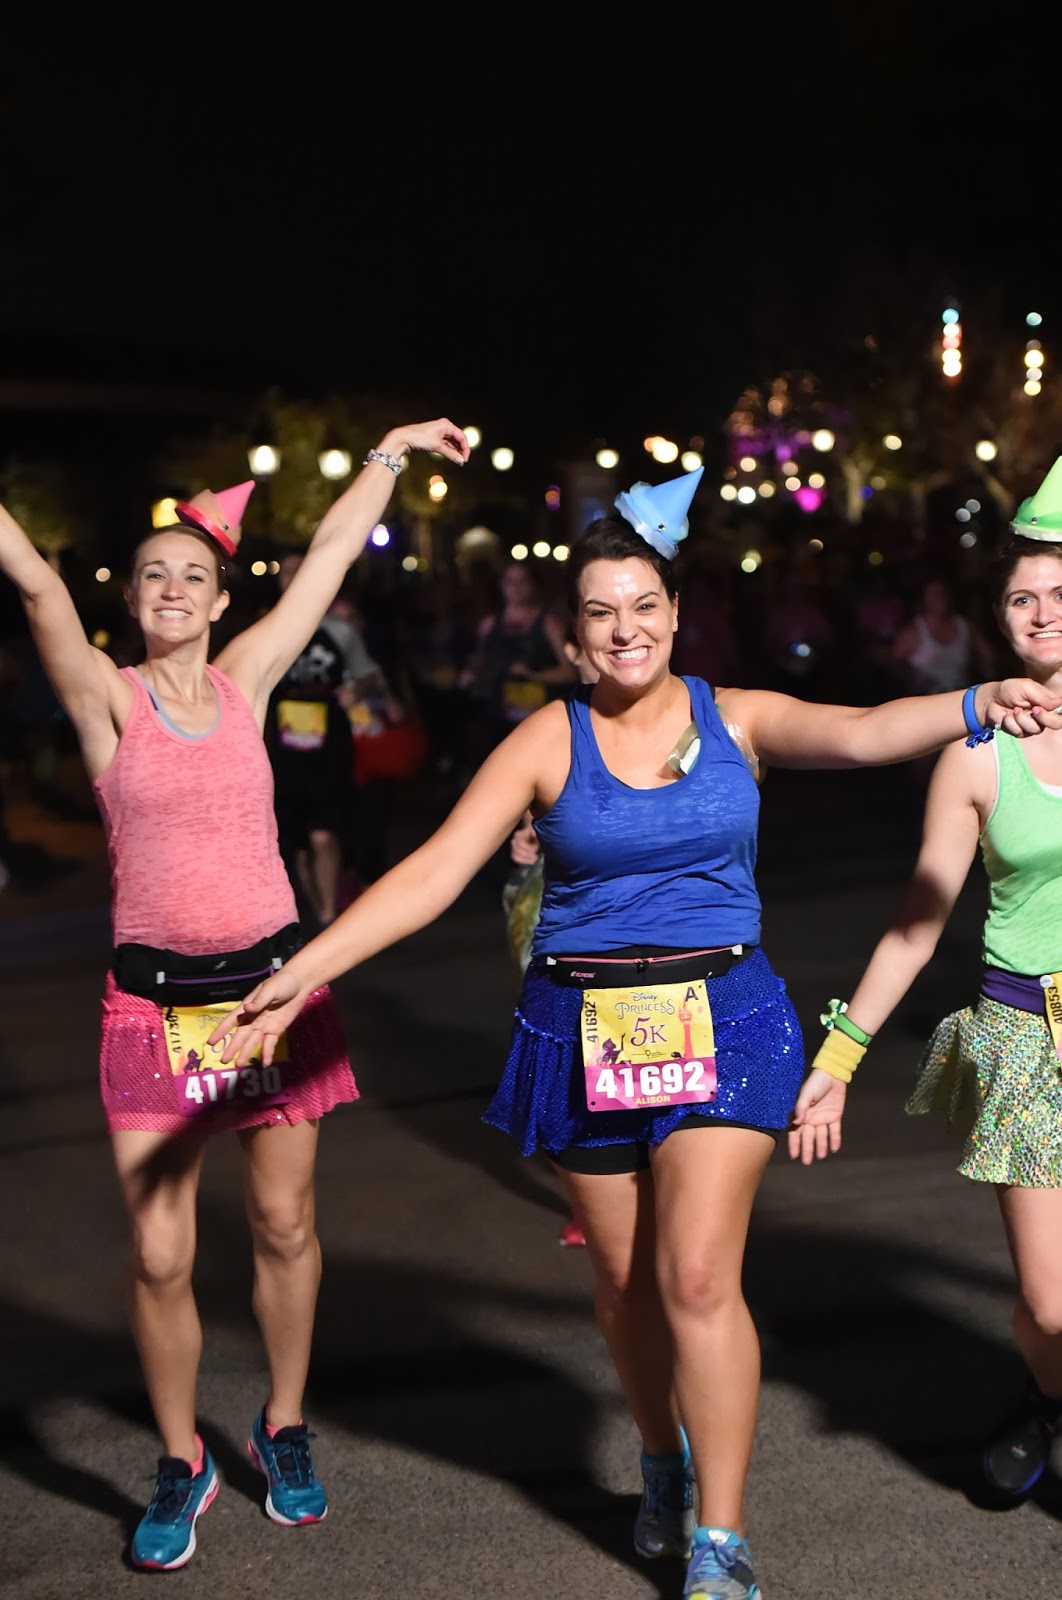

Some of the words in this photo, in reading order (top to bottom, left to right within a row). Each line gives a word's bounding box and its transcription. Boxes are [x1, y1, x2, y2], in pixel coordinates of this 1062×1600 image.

[630, 991, 659, 1002] Disney
[685, 986, 699, 1002] A
[584, 1001, 598, 1043] 41692
[614, 998, 675, 1020] PRINCESS
[630, 1016, 668, 1047] 5K
[185, 1065, 282, 1104] 41730
[595, 1060, 707, 1099] 41692
[635, 1095, 671, 1105] ALISON
